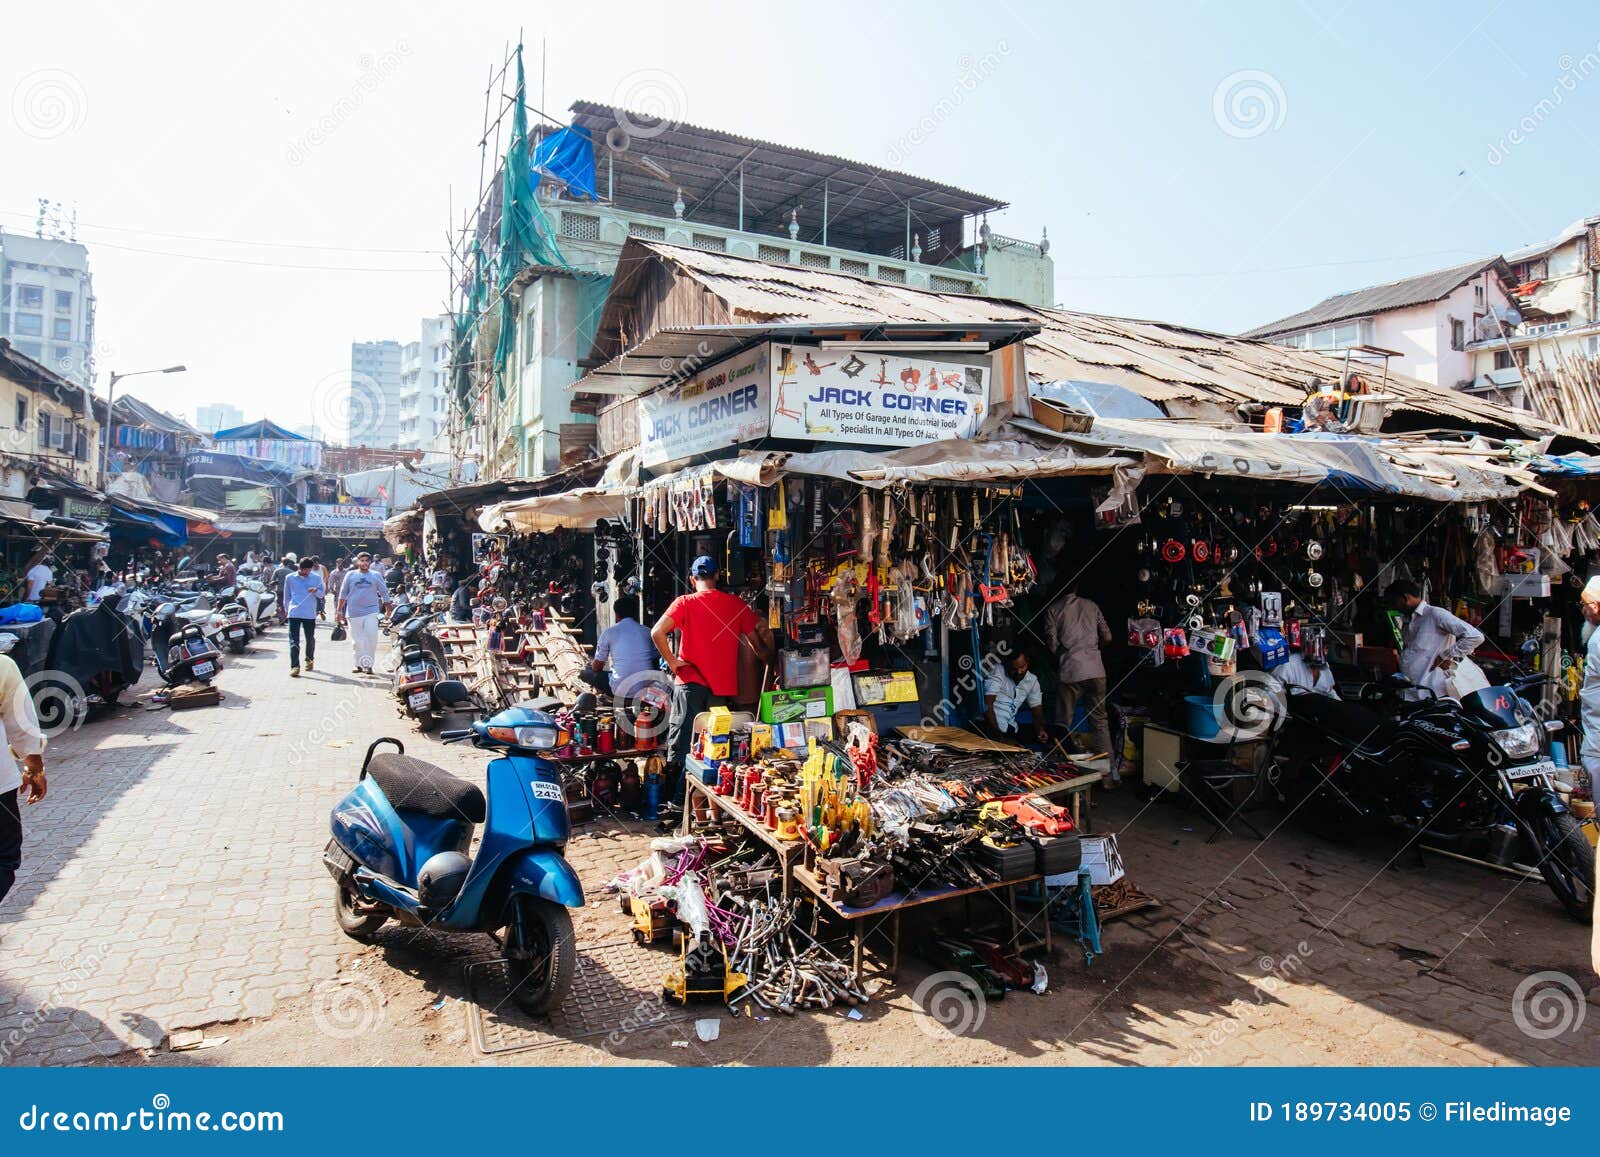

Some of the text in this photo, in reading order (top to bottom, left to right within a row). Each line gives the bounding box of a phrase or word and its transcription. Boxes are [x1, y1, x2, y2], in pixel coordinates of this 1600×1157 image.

[809, 386, 968, 416] JACK CORNER
[648, 413, 682, 442] JACK
[687, 384, 758, 429] CORNER
[820, 408, 957, 429] All Types Of Garage And Industrial Tools
[840, 423, 939, 440] Specialist In All Types Of Jack
[332, 505, 372, 515] ILYAS
